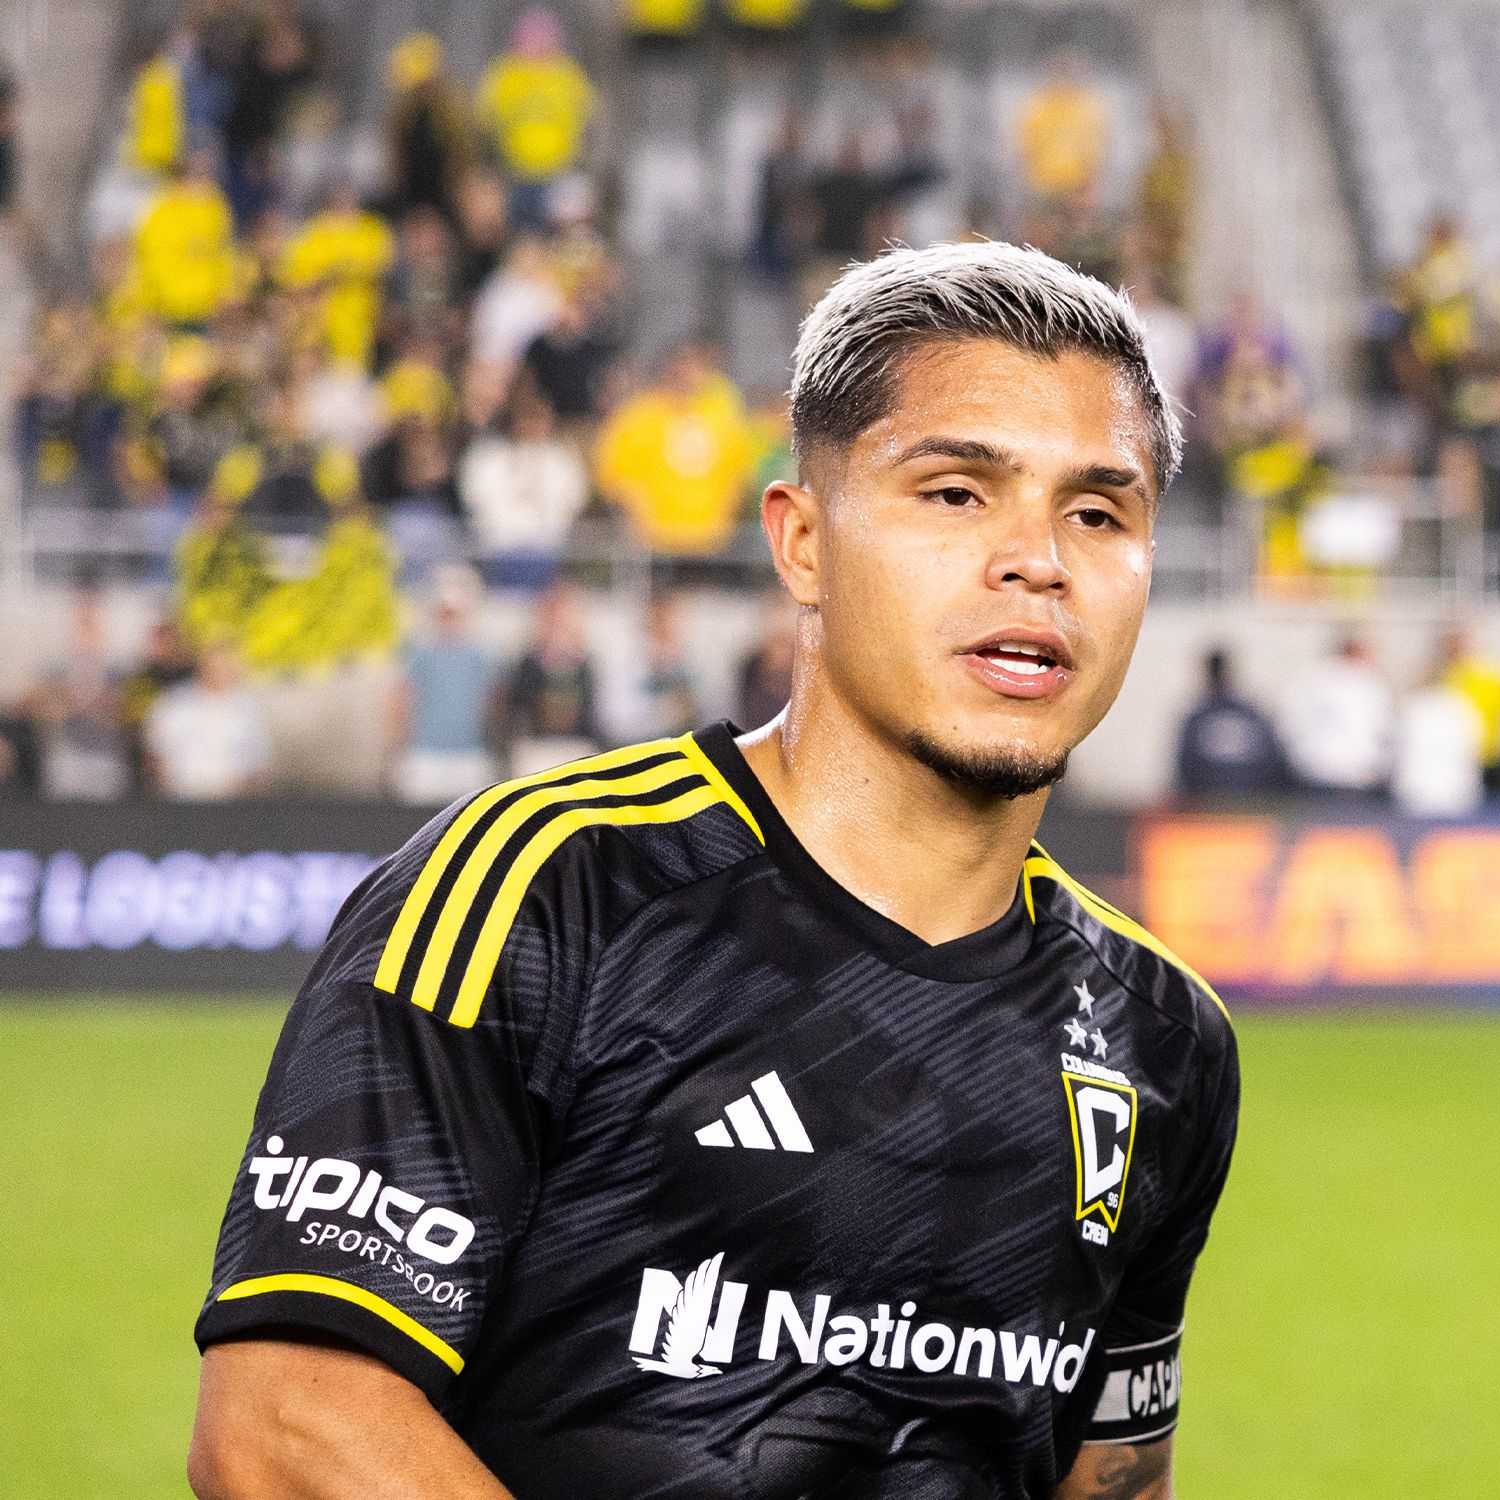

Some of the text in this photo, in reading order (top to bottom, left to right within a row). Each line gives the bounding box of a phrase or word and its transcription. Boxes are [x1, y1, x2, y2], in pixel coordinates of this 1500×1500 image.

[1076, 1086, 1131, 1204] C
[248, 1135, 476, 1265] tipico
[1082, 1219, 1109, 1247] CREW
[1107, 1192, 1119, 1209] 96
[299, 1221, 472, 1313] SPORTSBOOK
